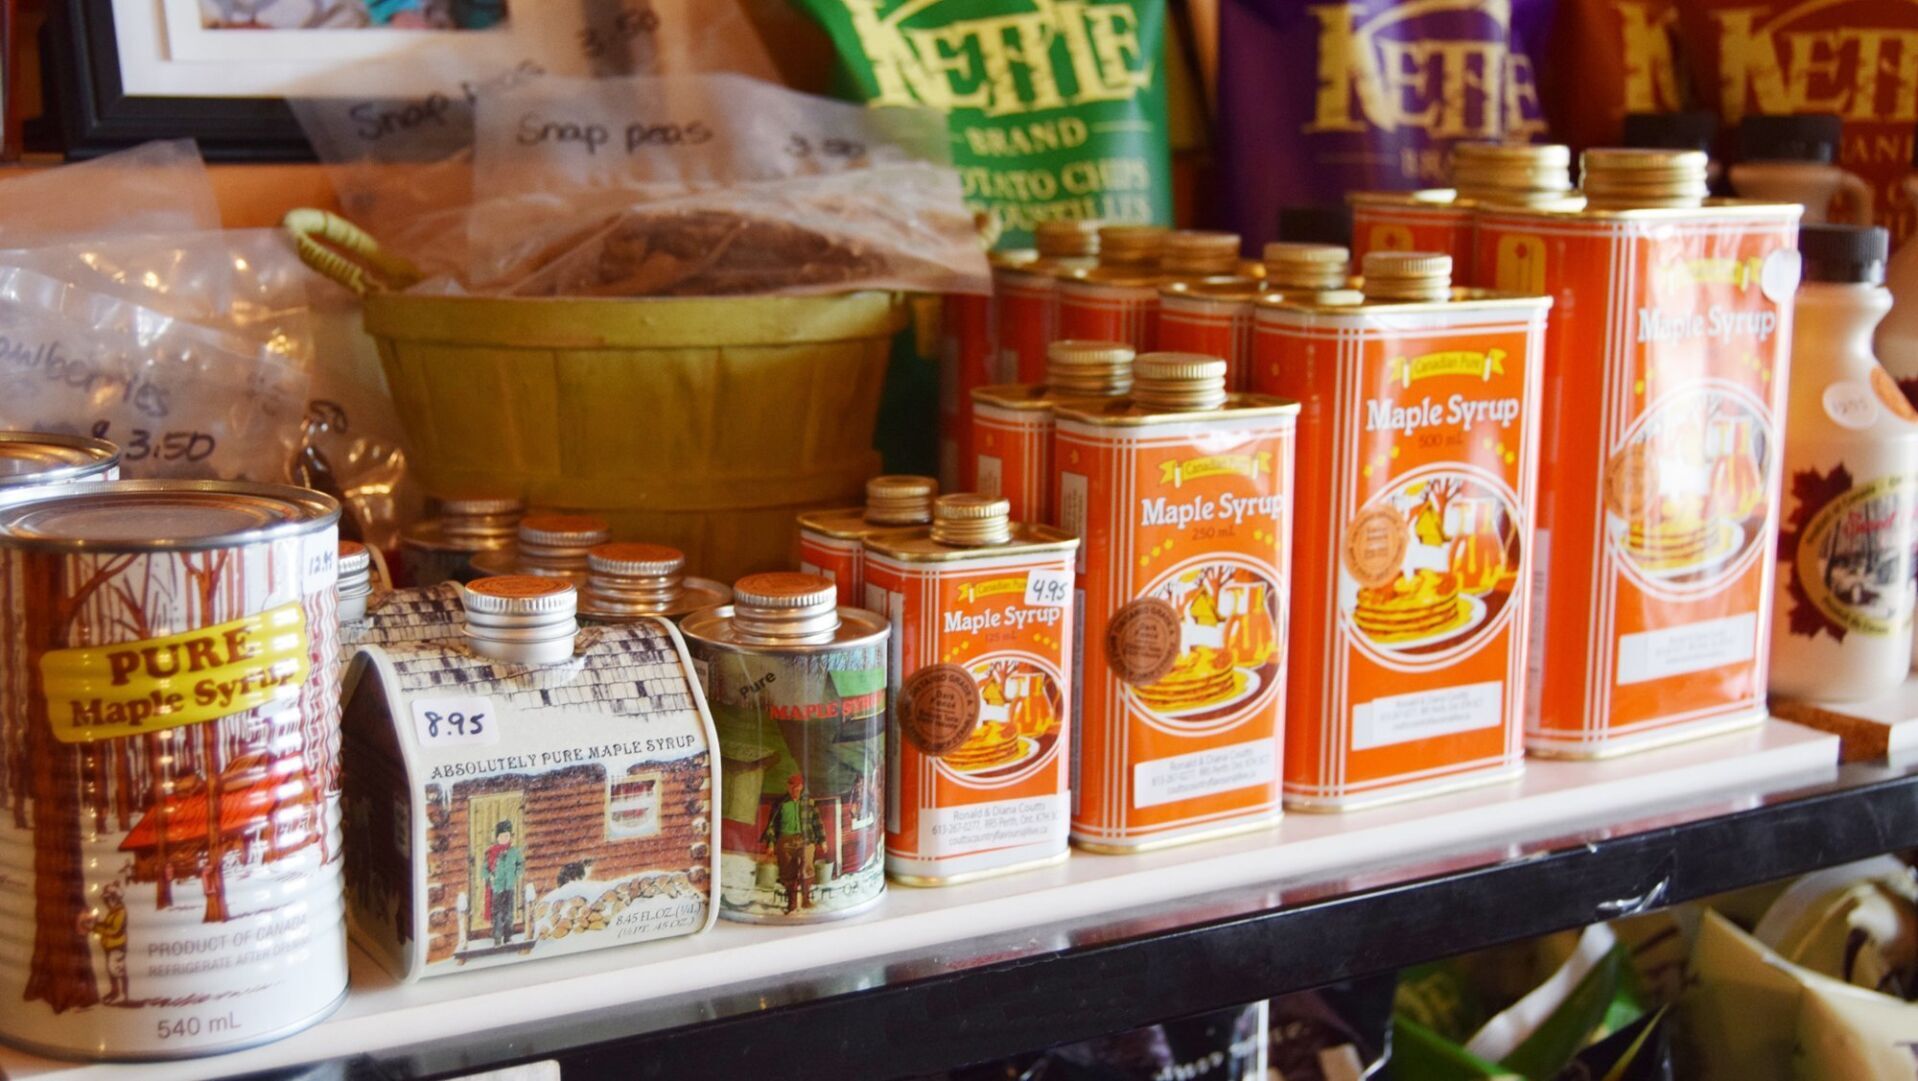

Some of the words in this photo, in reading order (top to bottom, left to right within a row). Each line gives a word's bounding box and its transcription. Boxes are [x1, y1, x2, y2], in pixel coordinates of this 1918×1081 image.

[516, 113, 609, 154] Snap
[965, 116, 1088, 157] BRAND
[1707, 303, 1777, 346] Syrup
[1366, 396, 1443, 437] Maple
[1446, 394, 1520, 432] Syrup
[124, 429, 216, 462] 3.50
[1141, 495, 1215, 530] Maple
[1218, 492, 1286, 524] Syrup
[1032, 579, 1069, 602] 4.95
[943, 608, 1002, 635] Maple
[1004, 605, 1060, 630] Syrup
[107, 626, 254, 686] PURE
[69, 690, 184, 728] Maple
[193, 667, 295, 708] Syrup
[739, 670, 777, 699] Pure
[425, 710, 485, 738] 8.95
[770, 703, 838, 721] MAPLE
[431, 752, 538, 780] ABSOLUTELY
[541, 747, 585, 768] PURE
[588, 740, 643, 761] MAPLE
[646, 734, 696, 754] SYRUP
[147, 935, 227, 958] PRODUCT
[233, 931, 253, 946] OF
[157, 1016, 201, 1040] 540
[208, 1011, 242, 1033] mL
